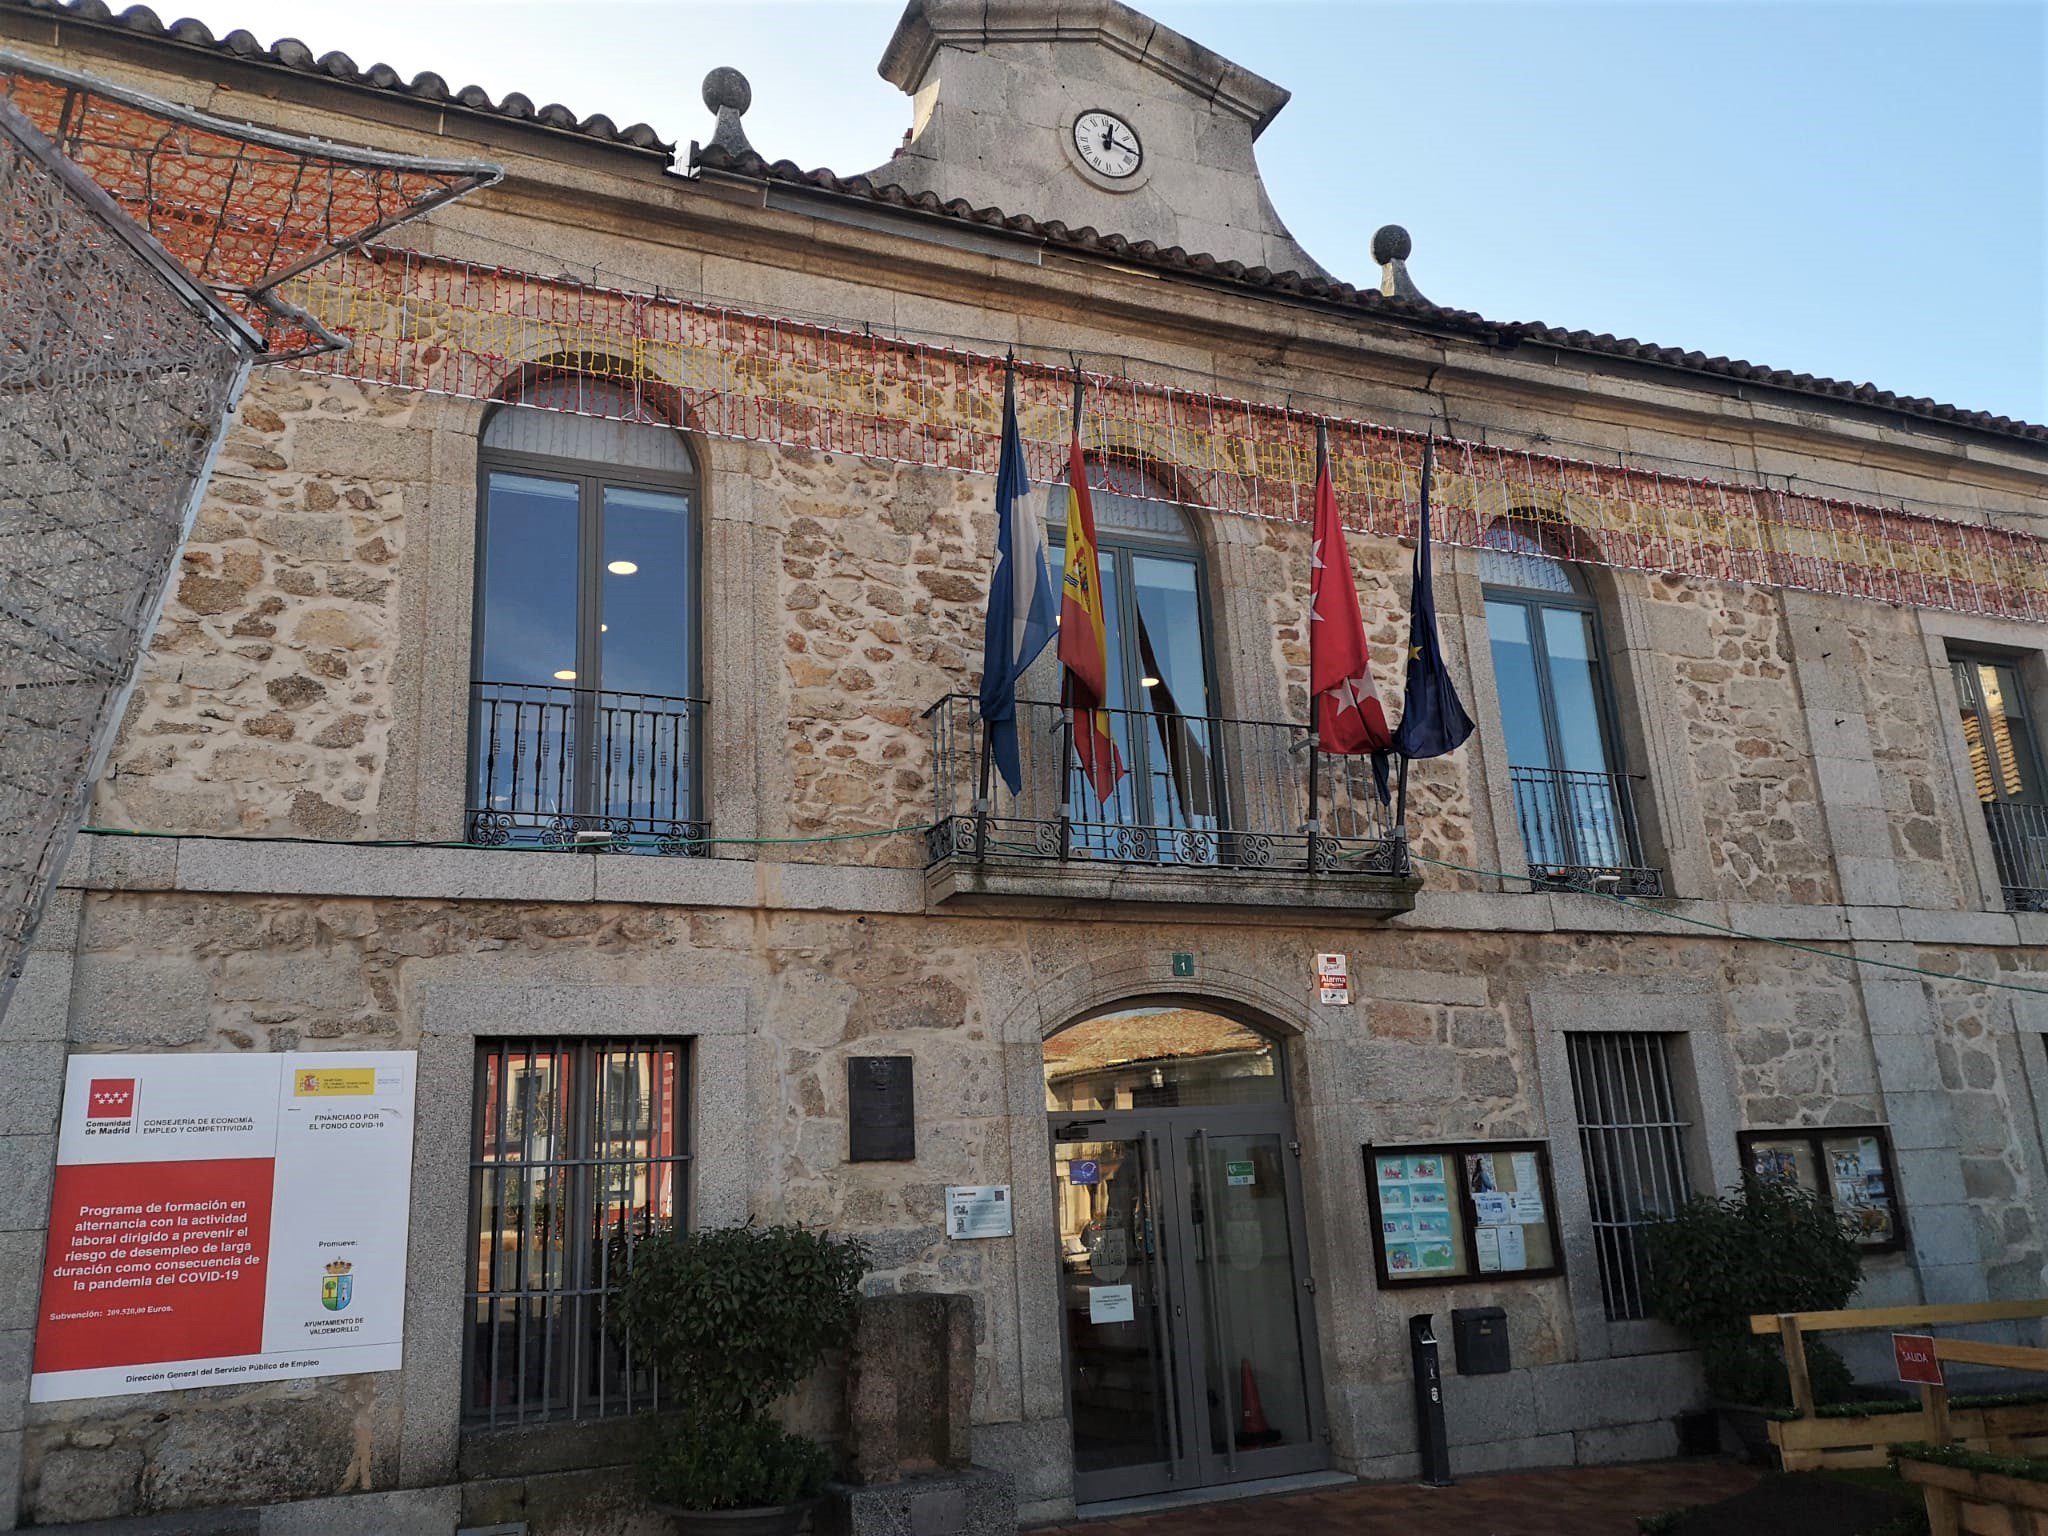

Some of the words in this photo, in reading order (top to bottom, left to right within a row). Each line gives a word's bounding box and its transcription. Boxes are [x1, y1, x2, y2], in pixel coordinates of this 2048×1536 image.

[1321, 975, 1346, 983] Alarma
[314, 1113, 362, 1121] FINANCIADO
[99, 1127, 130, 1135] Madrid
[143, 1126, 178, 1134] EMPLEO
[186, 1124, 253, 1133] COMPETITIVIDAD
[79, 1204, 143, 1218] Programa
[146, 1203, 161, 1213] de
[165, 1200, 228, 1213] formación
[231, 1200, 246, 1209] en
[75, 1217, 146, 1232] alternancia
[150, 1218, 174, 1227] con
[177, 1216, 189, 1226] la
[191, 1213, 247, 1225] actividad
[71, 1234, 116, 1247] laboral
[119, 1231, 169, 1245] dirigido
[171, 1233, 180, 1242] a
[183, 1228, 233, 1242] prevenir
[237, 1227, 248, 1237] el
[318, 1240, 358, 1248] Promueve:
[65, 1250, 106, 1263] riesgo
[110, 1248, 126, 1259] de
[129, 1244, 199, 1258] desempleo
[202, 1243, 218, 1253] de
[220, 1241, 252, 1253] larga
[53, 1263, 112, 1277] duración
[115, 1263, 151, 1273] como
[155, 1256, 241, 1271] consecuencia
[244, 1255, 261, 1265] de
[73, 1280, 85, 1291] la
[88, 1276, 152, 1292] pandemia
[155, 1273, 175, 1285] del
[178, 1270, 240, 1283] COVID-19
[49, 1310, 103, 1321] Subvención:
[147, 1305, 174, 1313] Euros.
[304, 1318, 354, 1328] AYUNTAMIENTO
[309, 1326, 360, 1335] VALDEMORILLO
[1901, 1351, 1928, 1364] SALIDA
[126, 1373, 165, 1383] Dirección
[167, 1369, 199, 1379] General
[200, 1367, 213, 1376] del
[214, 1365, 247, 1374] Servicio
[249, 1362, 278, 1372] Público
[279, 1361, 289, 1369] de
[291, 1359, 320, 1369] Empleo
